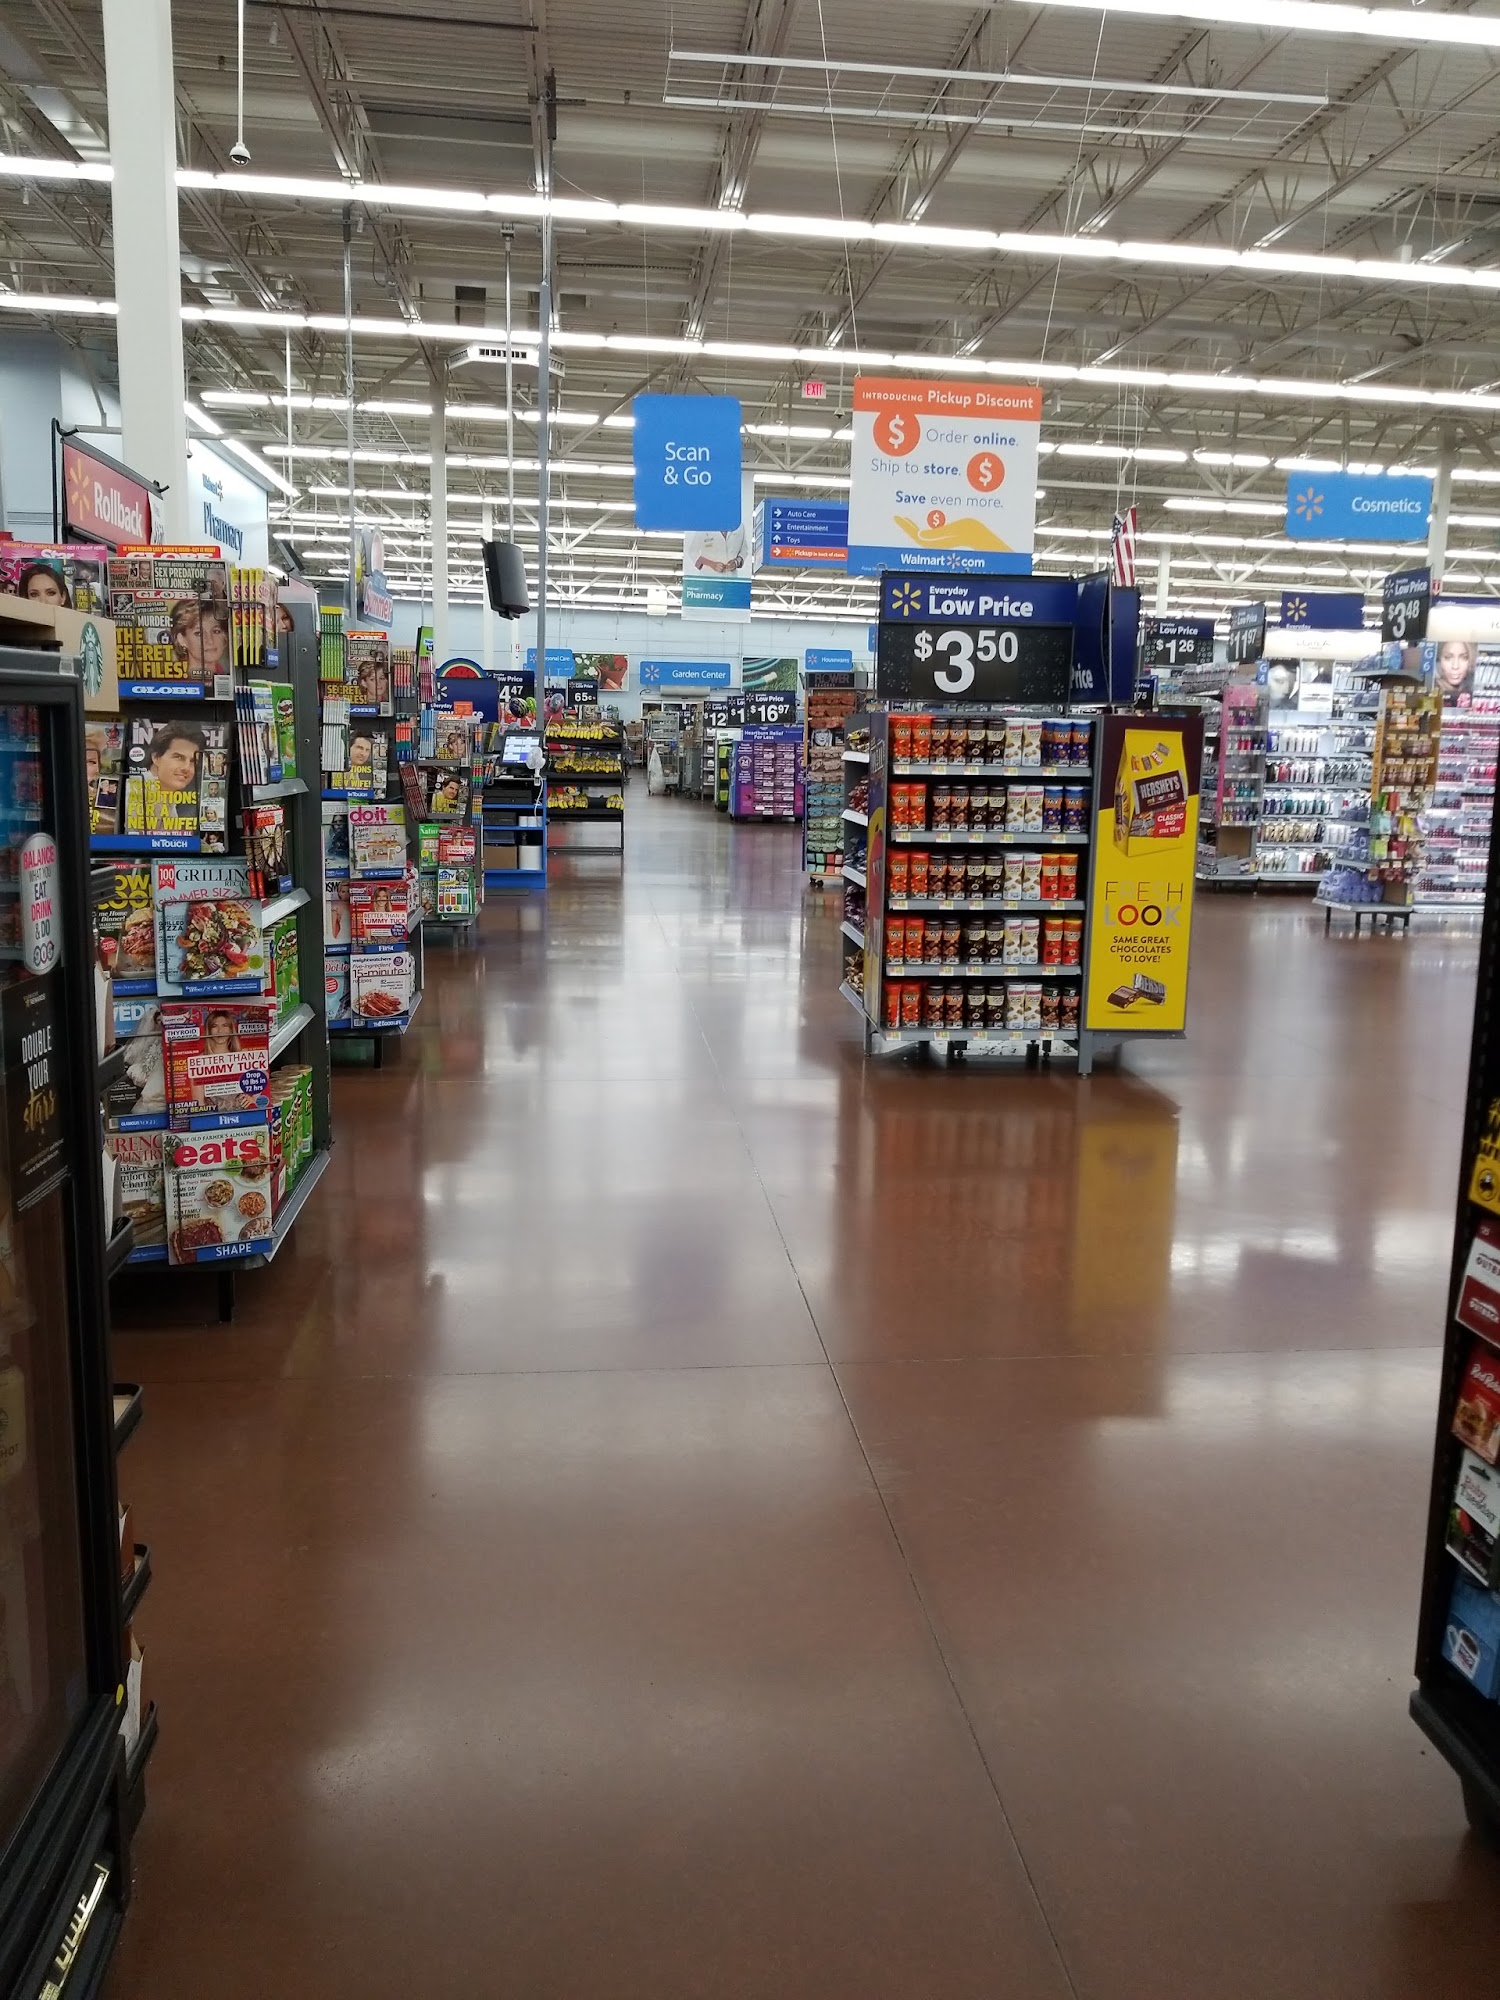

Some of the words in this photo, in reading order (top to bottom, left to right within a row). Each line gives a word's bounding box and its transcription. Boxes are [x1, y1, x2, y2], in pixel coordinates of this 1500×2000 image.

[806, 382, 824, 396] EXIT
[862, 391, 923, 402] INTRODUCING
[927, 390, 972, 408] Pickup
[975, 393, 1033, 409] Discount
[926, 428, 968, 444] Order
[973, 432, 1019, 447] online.
[665, 441, 710, 462] Scan
[871, 459, 900, 477] Ship
[905, 461, 919, 474] to
[923, 463, 961, 476] store.
[664, 466, 679, 485] &
[684, 466, 712, 486] Go
[895, 490, 926, 505] Save
[931, 494, 962, 506] even
[966, 496, 1004, 508] more.
[1351, 496, 1422, 514] Cosmetics
[93, 481, 143, 538] Rollback
[787, 510, 802, 518] Auto
[203, 501, 244, 561] Pharmacy
[787, 523, 829, 532] Entertainment
[786, 536, 801, 544] Toys
[41, 549, 75, 560] Star
[794, 549, 813, 558] Pickup
[900, 553, 945, 566] Walmart
[961, 558, 985, 568] com
[155, 567, 168, 577] SEX
[168, 568, 205, 579] PREDATOR
[155, 579, 169, 588] TOM
[170, 579, 192, 589] JONES!
[929, 585, 969, 597] Everyday
[1394, 583, 1409, 596] Low
[1409, 580, 1428, 593] Price
[136, 590, 199, 600] GLOBE
[686, 591, 724, 601] Pharmacy
[928, 595, 975, 616] Low
[978, 595, 1034, 618] Price
[137, 615, 173, 628] MURDER:
[1237, 612, 1246, 626] Low
[1246, 611, 1258, 624] Price
[116, 628, 144, 644] THE
[1159, 626, 1176, 635] Low
[1177, 626, 1199, 636] Price
[116, 644, 173, 661] SECRET
[821, 656, 850, 664] Housewares
[117, 661, 141, 678] CIA
[142, 661, 188, 679] FILES!
[672, 669, 700, 679] Garden
[701, 670, 726, 679] Center
[1070, 663, 1094, 690] Price
[814, 672, 850, 684] FLOWER
[131, 686, 200, 695] GLOBE
[350, 780, 371, 788] WIFE!
[1139, 775, 1180, 799] HERSHEY'S
[128, 791, 197, 805] AUDITIONS
[128, 804, 155, 816] FOR
[160, 804, 169, 817] A
[1157, 812, 1184, 822] CLASSIC
[128, 817, 158, 830] NEW
[163, 818, 198, 830] WIFE!
[22, 845, 55, 870] BALANCE
[29, 869, 42, 882] WHAT
[42, 866, 52, 878] YOU
[159, 869, 175, 880] 100
[34, 881, 47, 901] EAT
[159, 888, 208, 906] SUMMER
[1105, 880, 1184, 902] FRESH
[31, 899, 52, 922] DRINK
[1104, 904, 1182, 927] LOOK
[40, 919, 50, 938] DO
[1113, 936, 1138, 944] SAME
[1140, 936, 1170, 944] GREAT
[1110, 945, 1171, 954] CHOCOLATES
[1120, 955, 1132, 963] TO
[1134, 955, 1161, 963] LOVE!
[21, 1025, 52, 1064] DOUBLE
[189, 1056, 225, 1067] BETTER
[228, 1053, 255, 1062] THAN
[258, 1051, 265, 1059] A
[27, 1058, 49, 1092] YOUR
[189, 1063, 234, 1076] TUMMY
[238, 1060, 267, 1071] TUCK
[190, 1105, 217, 1113] BEAUTY
[173, 1138, 260, 1167] eats
[215, 1242, 252, 1257] SHAPE
